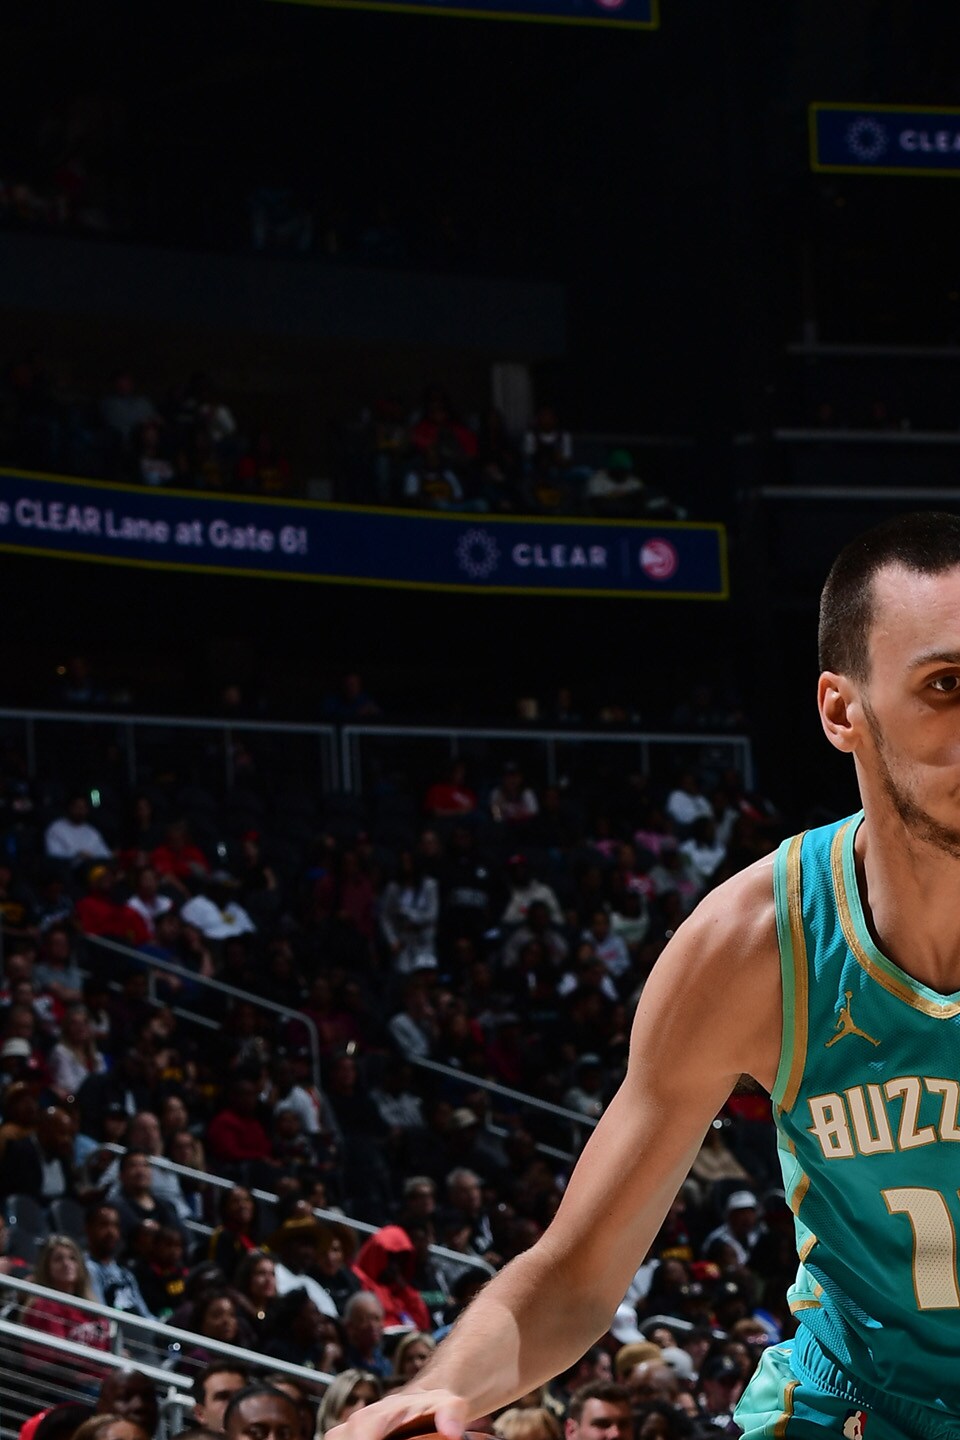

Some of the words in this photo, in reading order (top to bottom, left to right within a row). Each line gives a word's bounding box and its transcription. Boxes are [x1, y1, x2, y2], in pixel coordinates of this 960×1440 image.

[14, 498, 101, 536] CLEAR
[104, 508, 171, 544] Lane
[174, 519, 205, 547] at
[208, 518, 275, 553] Gate
[279, 524, 309, 555] 6!
[511, 542, 608, 569] CLEAR
